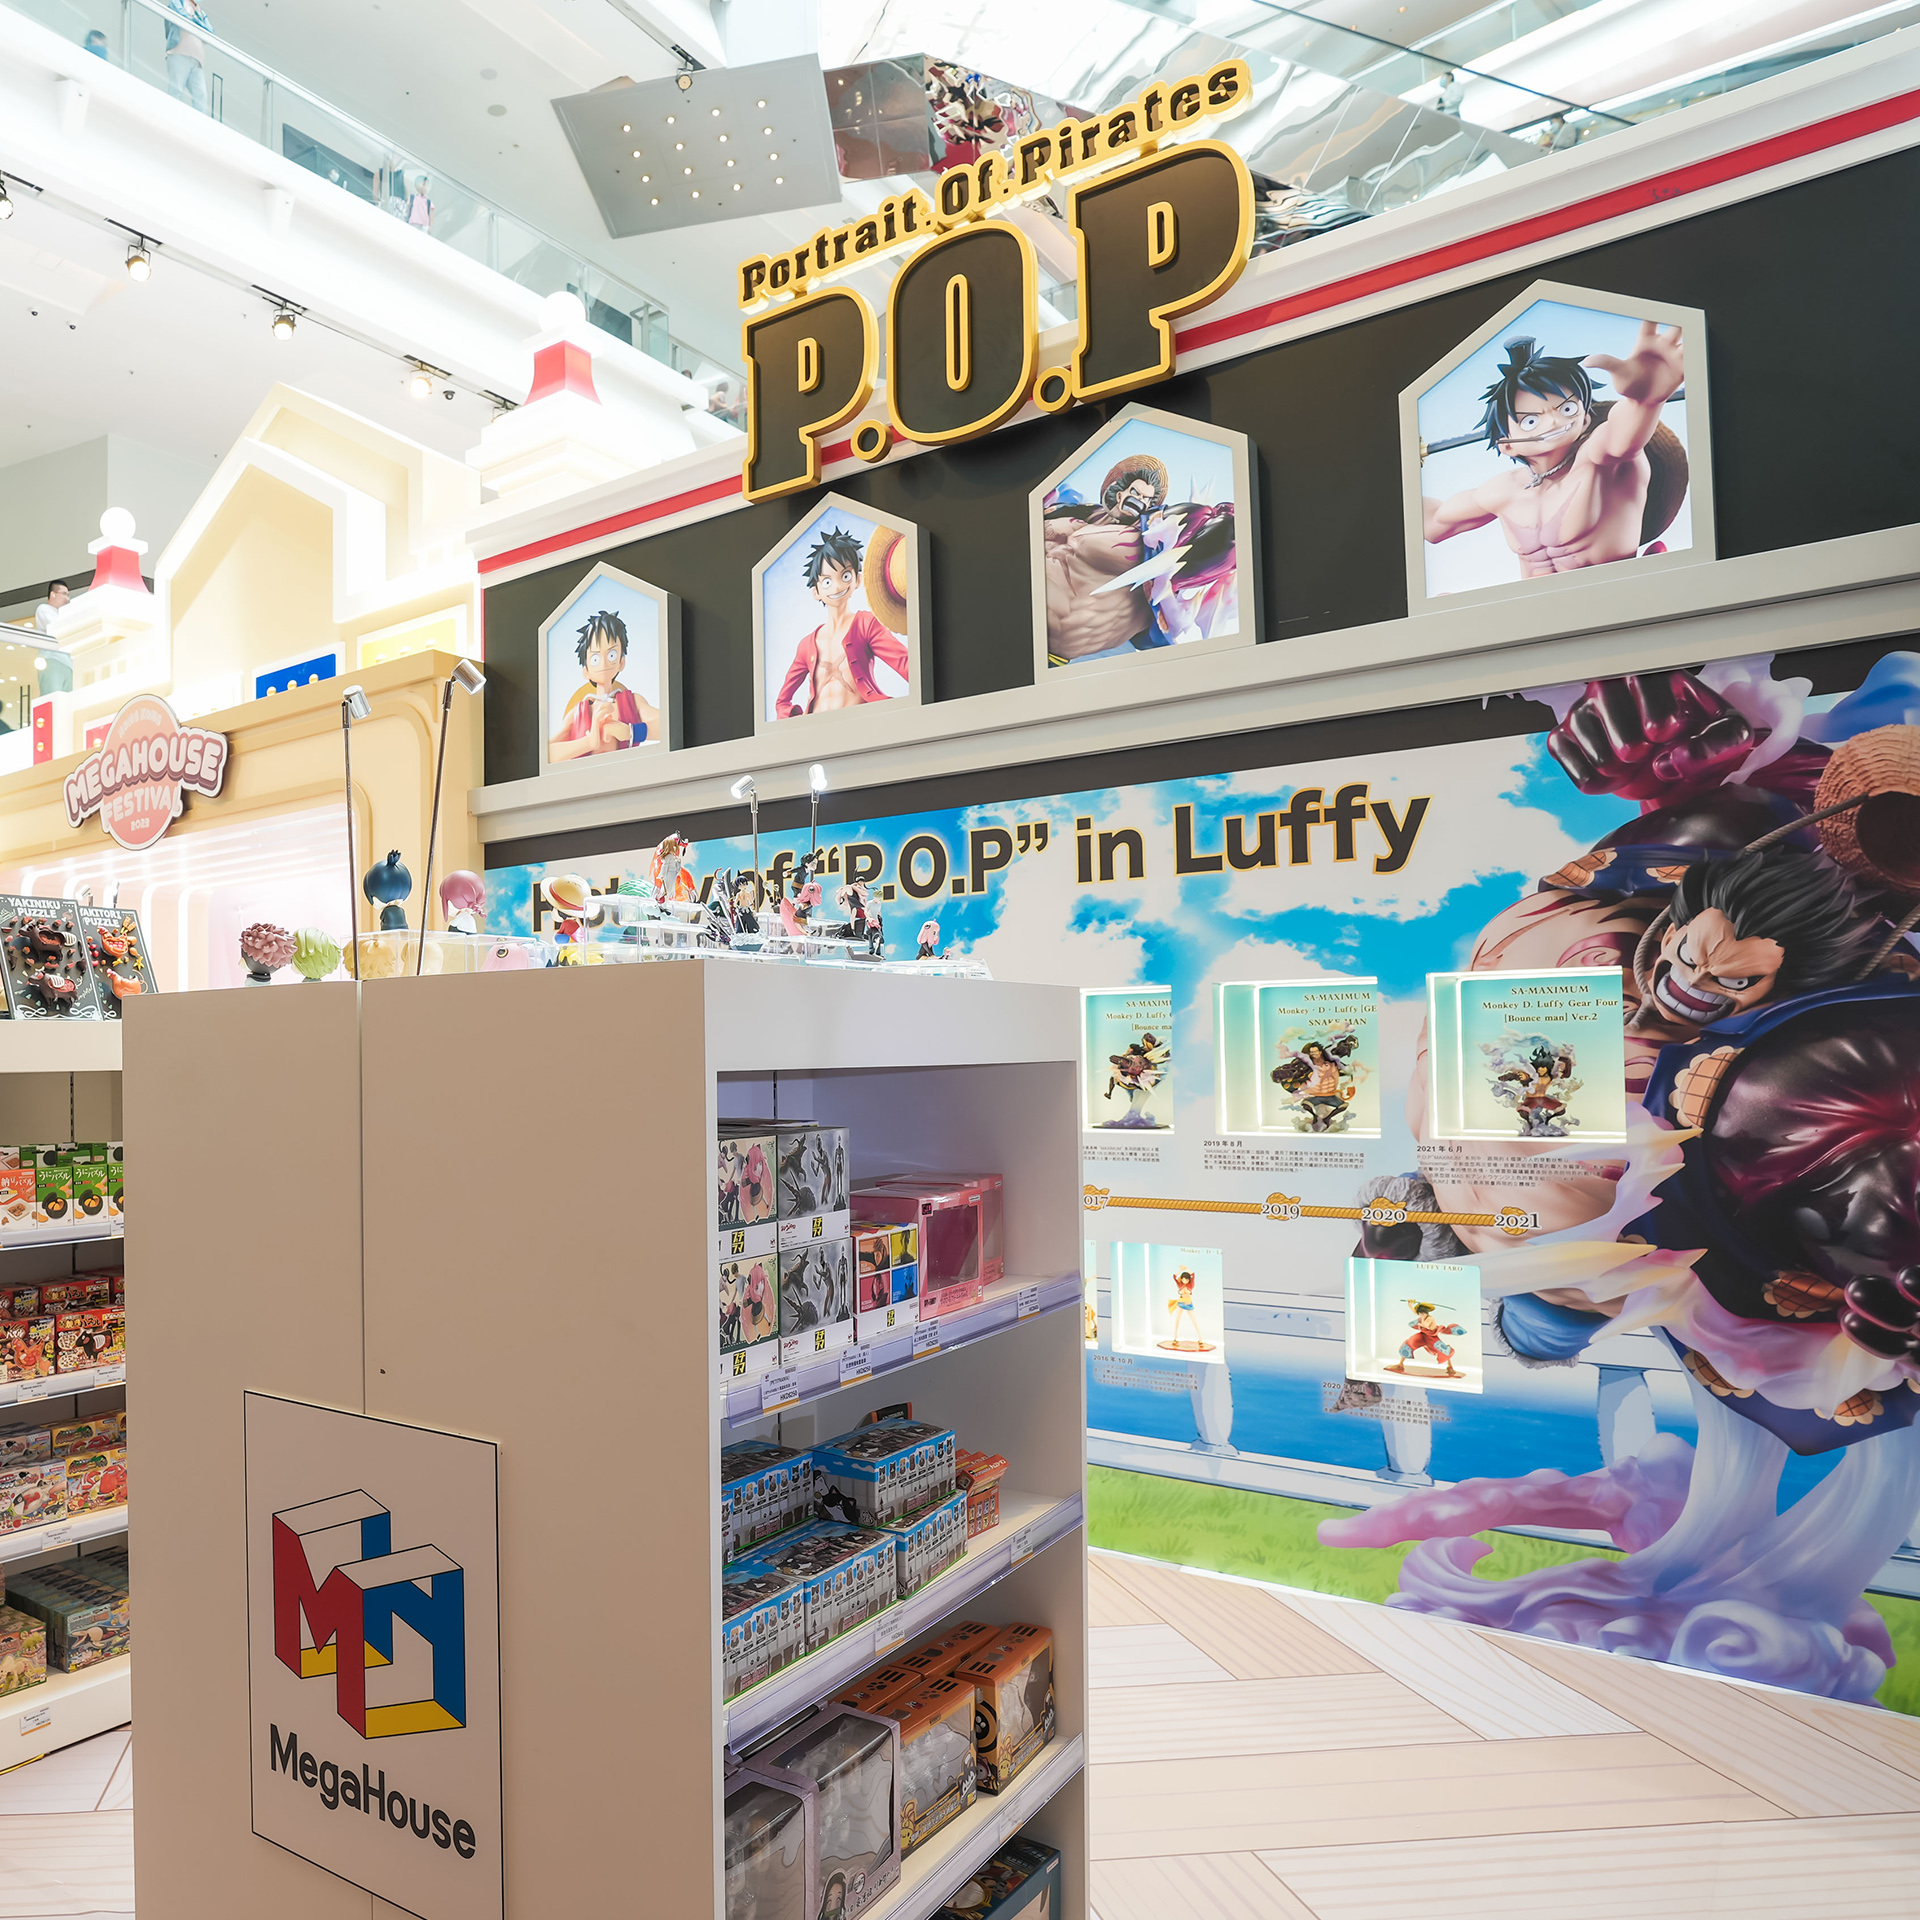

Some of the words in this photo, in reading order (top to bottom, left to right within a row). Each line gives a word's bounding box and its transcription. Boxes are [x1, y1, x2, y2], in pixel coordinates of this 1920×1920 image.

[1019, 66, 1240, 184] Pirates
[742, 139, 1256, 504] P.O.P
[66, 735, 223, 815] MEGAHOUSE
[102, 785, 181, 829] FESTIVAL
[1076, 815, 1146, 884] in
[1172, 782, 1433, 876] Luffy
[8, 897, 61, 910] YAKINIKU
[17, 907, 57, 918] PUZZLE
[83, 917, 120, 928] PUZZLE
[1278, 1007, 1309, 1015] Monkey
[1334, 1005, 1358, 1013] Luffy
[1482, 1001, 1519, 1010] Monkey
[1523, 1000, 1533, 1009] D.
[1536, 1000, 1565, 1008] Luffy
[1568, 999, 1592, 1008] Gear
[1595, 998, 1619, 1007] Four
[1105, 1012, 1133, 1021] Monkey
[1504, 1013, 1541, 1023] [Bounce
[1544, 1012, 1568, 1022] man]
[1571, 1012, 1598, 1021] Ver.2
[1084, 1195, 1108, 1209] 017
[1261, 1204, 1300, 1220] 2019
[1361, 1208, 1406, 1222] 2020
[1495, 1213, 1541, 1229] 2021
[1416, 1263, 1440, 1271] LUFFY
[1322, 1381, 1341, 1390] 2020
[270, 1722, 477, 1860] MegaHouse
